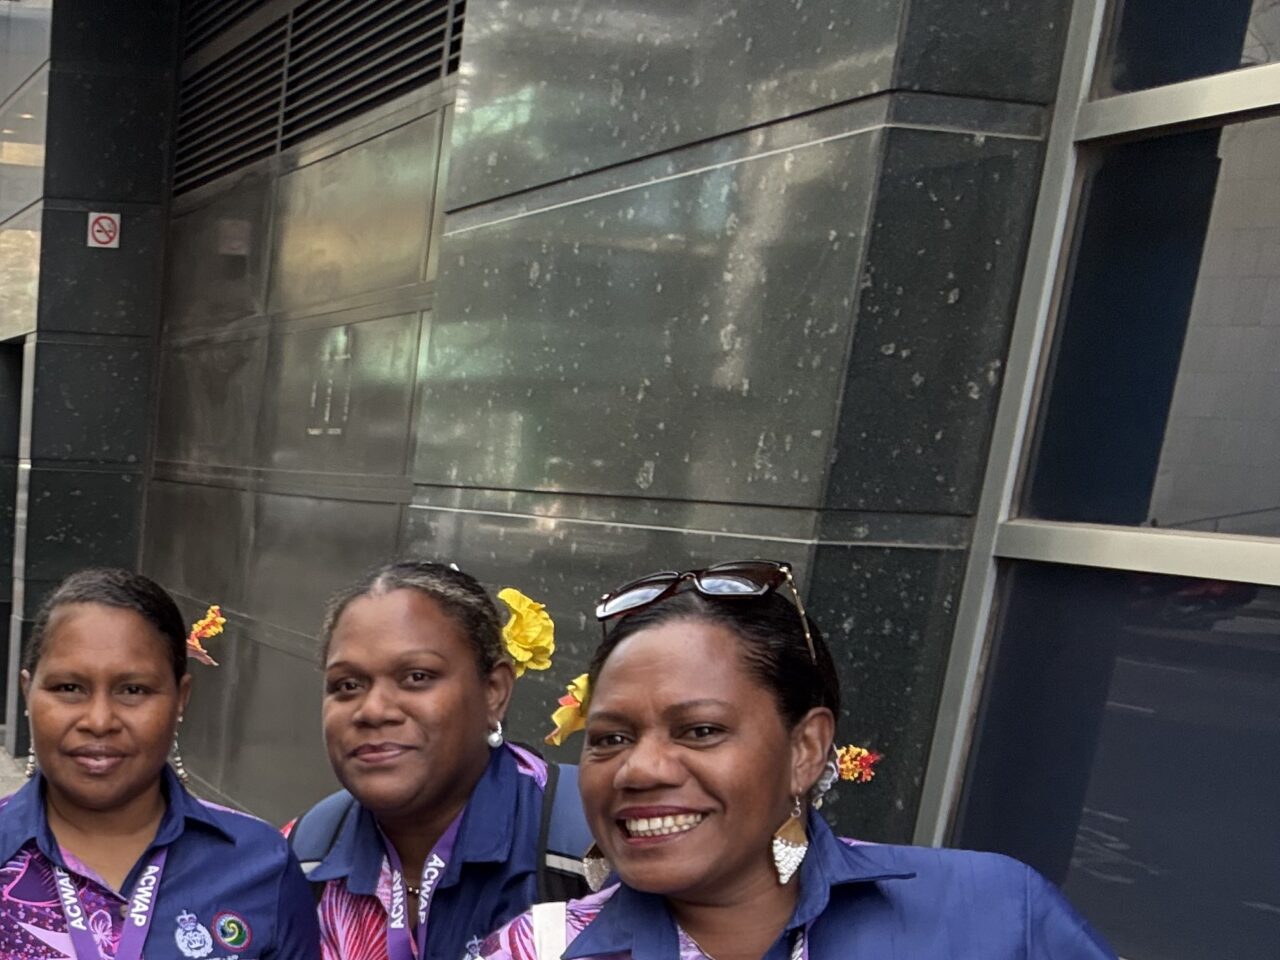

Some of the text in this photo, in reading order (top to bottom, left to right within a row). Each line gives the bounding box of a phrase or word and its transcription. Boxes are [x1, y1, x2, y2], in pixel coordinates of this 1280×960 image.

[130, 865, 160, 927] ACWAP
[390, 869, 405, 929] ACWAP
[417, 853, 446, 925] ACWAP
